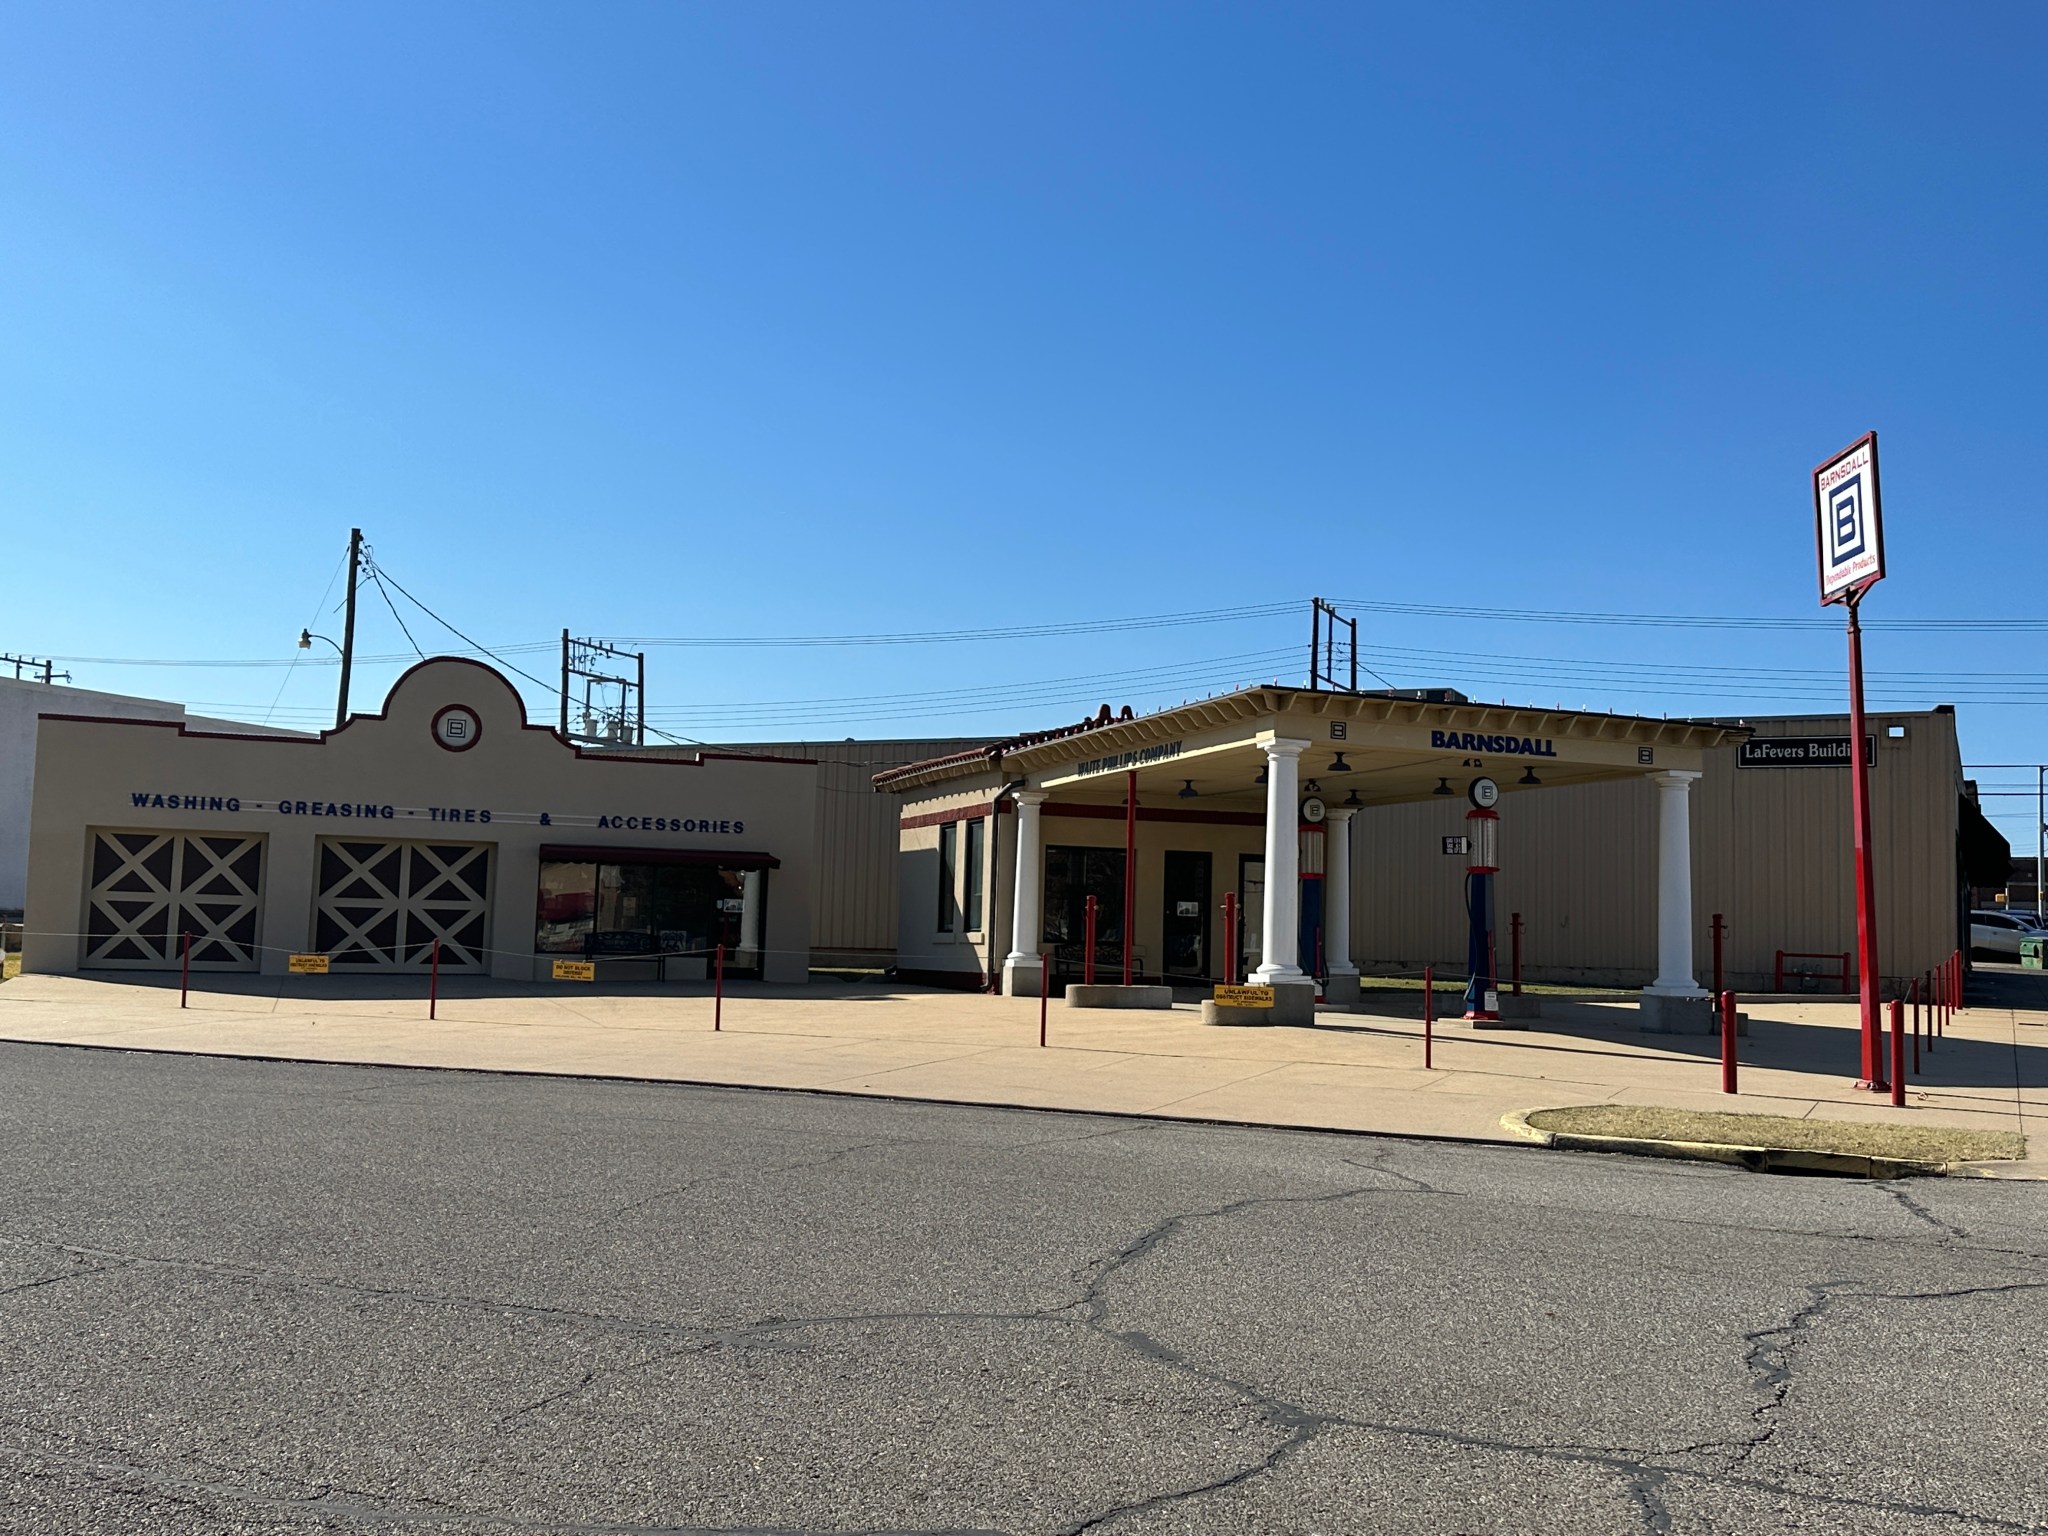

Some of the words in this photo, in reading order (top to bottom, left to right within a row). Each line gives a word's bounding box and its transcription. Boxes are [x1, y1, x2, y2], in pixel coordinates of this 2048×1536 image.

[1820, 451, 1869, 491] BARNSDALL
[1835, 494, 1856, 547] B
[1825, 564, 1852, 586] Dependable
[1852, 553, 1876, 573] Products
[449, 721, 464, 735] B
[1431, 730, 1557, 757] BARNSDALL
[1077, 758, 1102, 775] WAITE
[1102, 750, 1138, 770] PHILLIPS
[1139, 740, 1183, 762] COMPANY
[1745, 743, 1805, 758] LaFevers
[1808, 742, 1868, 758] Buildi
[131, 793, 240, 812] WASHING
[278, 800, 395, 819] GREASING
[428, 807, 492, 823] TIRES
[539, 812, 551, 826] &
[598, 815, 744, 834] ACCESSORIES
